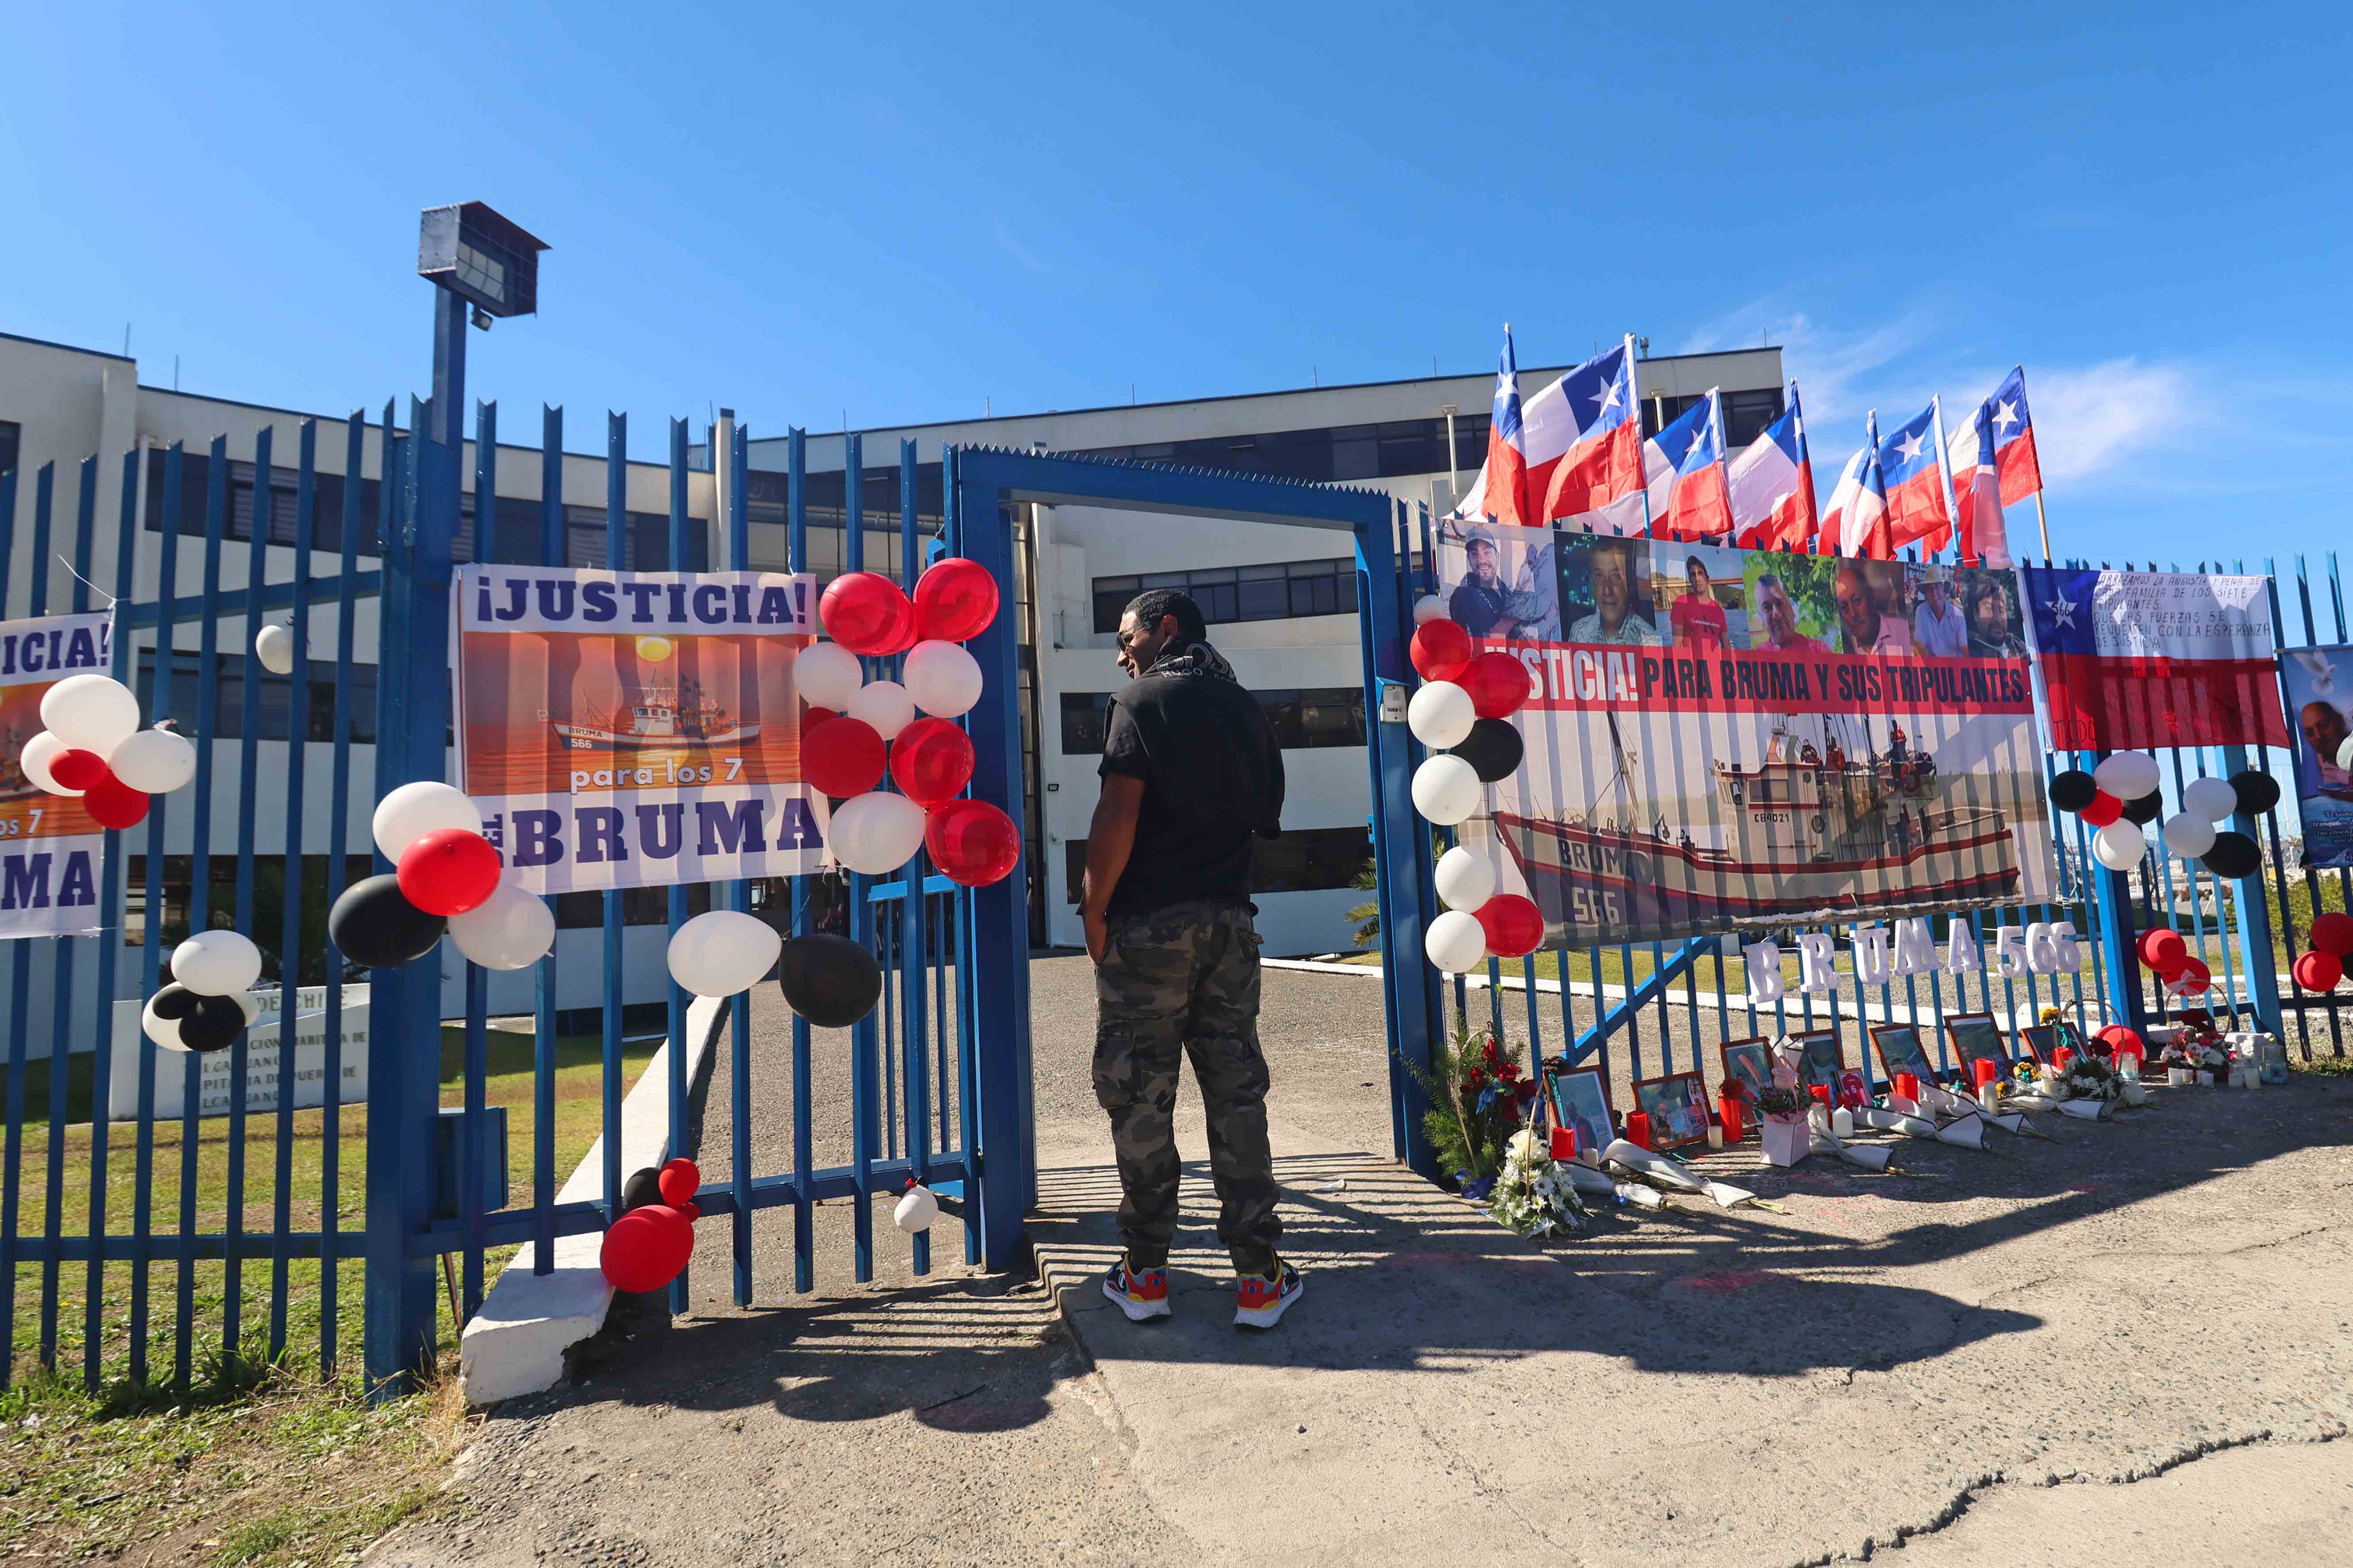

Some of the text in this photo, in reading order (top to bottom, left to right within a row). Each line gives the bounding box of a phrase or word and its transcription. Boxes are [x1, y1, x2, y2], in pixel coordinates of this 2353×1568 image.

[2153, 577, 2164, 586] LA
[478, 576, 806, 624] ¡JUSTICIA!
[2125, 587, 2166, 598] FAMILIA
[2174, 587, 2186, 598] DE
[2191, 587, 2211, 598] LOS
[2051, 602, 2070, 616] 566
[2094, 612, 2114, 623] QUE
[2150, 612, 2199, 624] FUERZAS
[2209, 611, 2225, 622] SE
[2158, 624, 2183, 637] CON
[2187, 625, 2201, 637] LA
[2206, 623, 2271, 638] ESPERANZA
[1485, 646, 2024, 703] STICIA! PARA BRUMA Y SUS TRIPULANTES
[568, 726, 602, 738] BRUMA
[571, 738, 592, 748] 566
[570, 757, 744, 796] para los 7
[28, 809, 43, 834] 7
[512, 797, 824, 868] BRUMA
[1572, 886, 1620, 925] 566
[1742, 917, 2082, 1004] BRUMA 566
